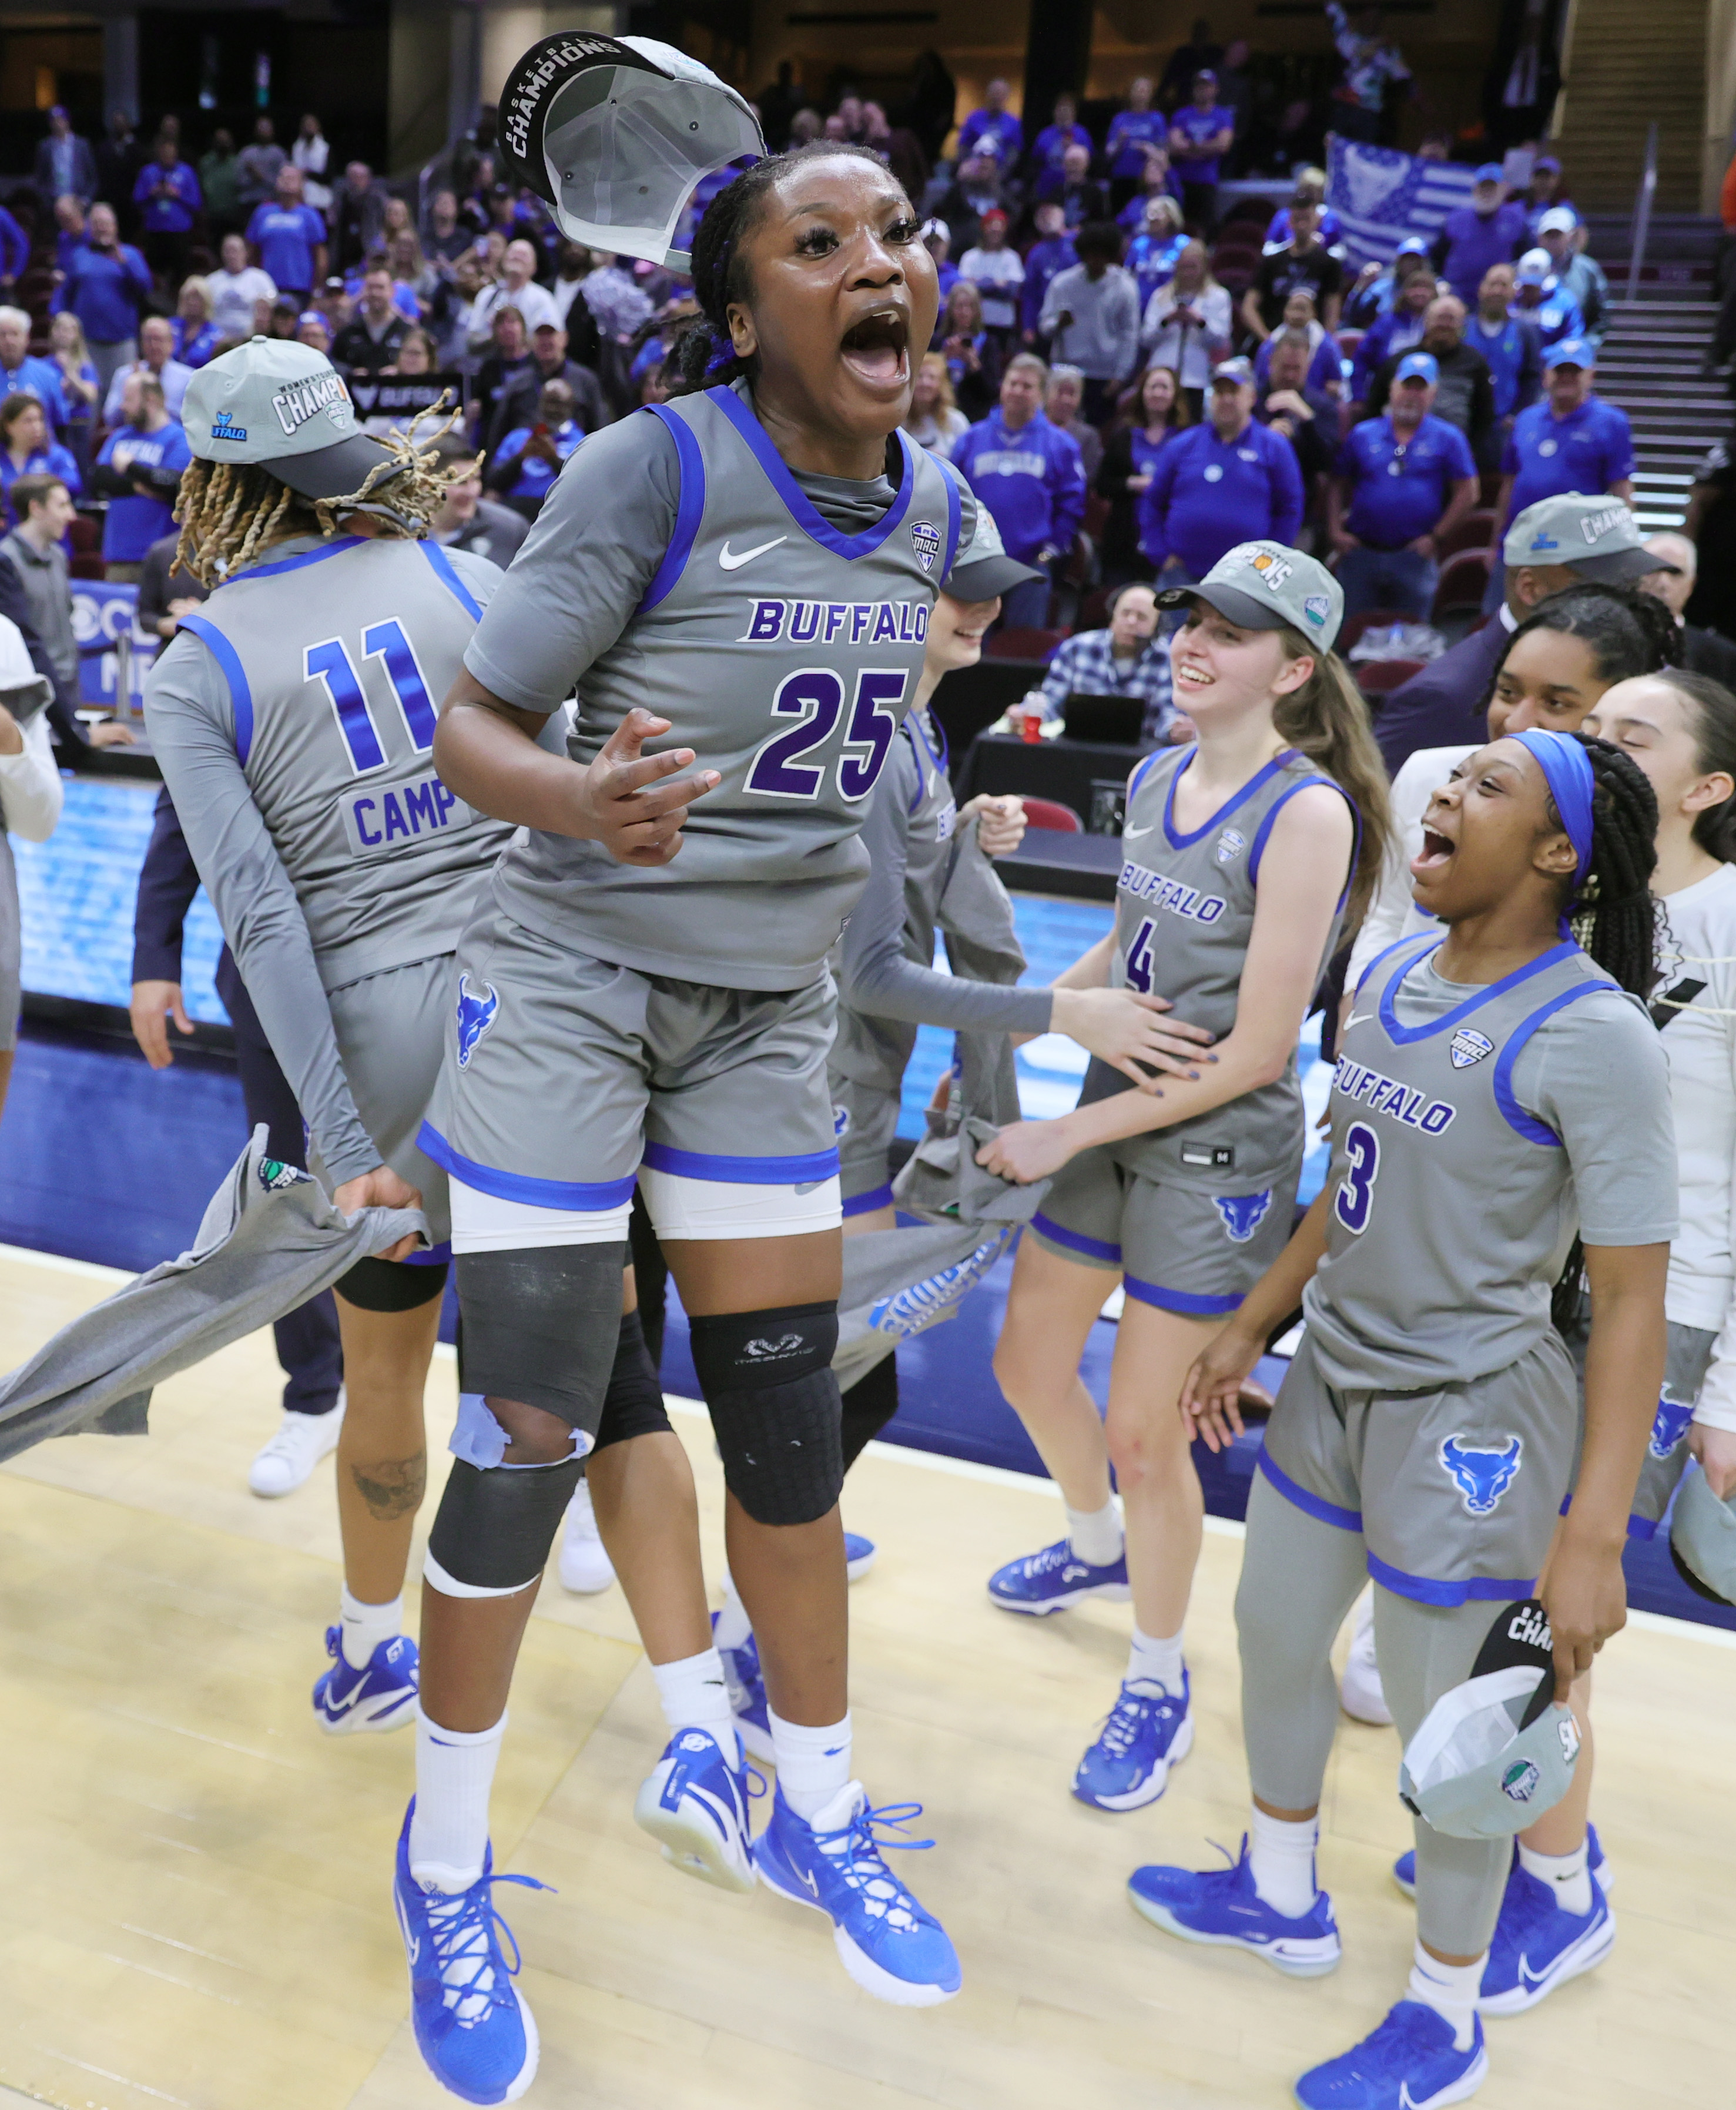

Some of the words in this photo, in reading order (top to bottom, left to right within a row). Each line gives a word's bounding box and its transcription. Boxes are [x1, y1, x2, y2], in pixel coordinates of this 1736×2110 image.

[506, 38, 600, 142] BASKETBALL
[512, 42, 621, 158] CHAMPIONS
[914, 535, 939, 555] MAC
[735, 598, 928, 645] BUFFALO
[302, 615, 440, 777] 11
[742, 668, 909, 802] 25
[353, 779, 456, 846] CAMP
[1116, 859, 1227, 925] BUFFALO
[1125, 915, 1158, 996] 4
[1451, 1036, 1488, 1060] MAC
[1332, 1053, 1457, 1136] BUFFALO
[1217, 1152, 1229, 1163] M
[1334, 1121, 1381, 1235] 3
